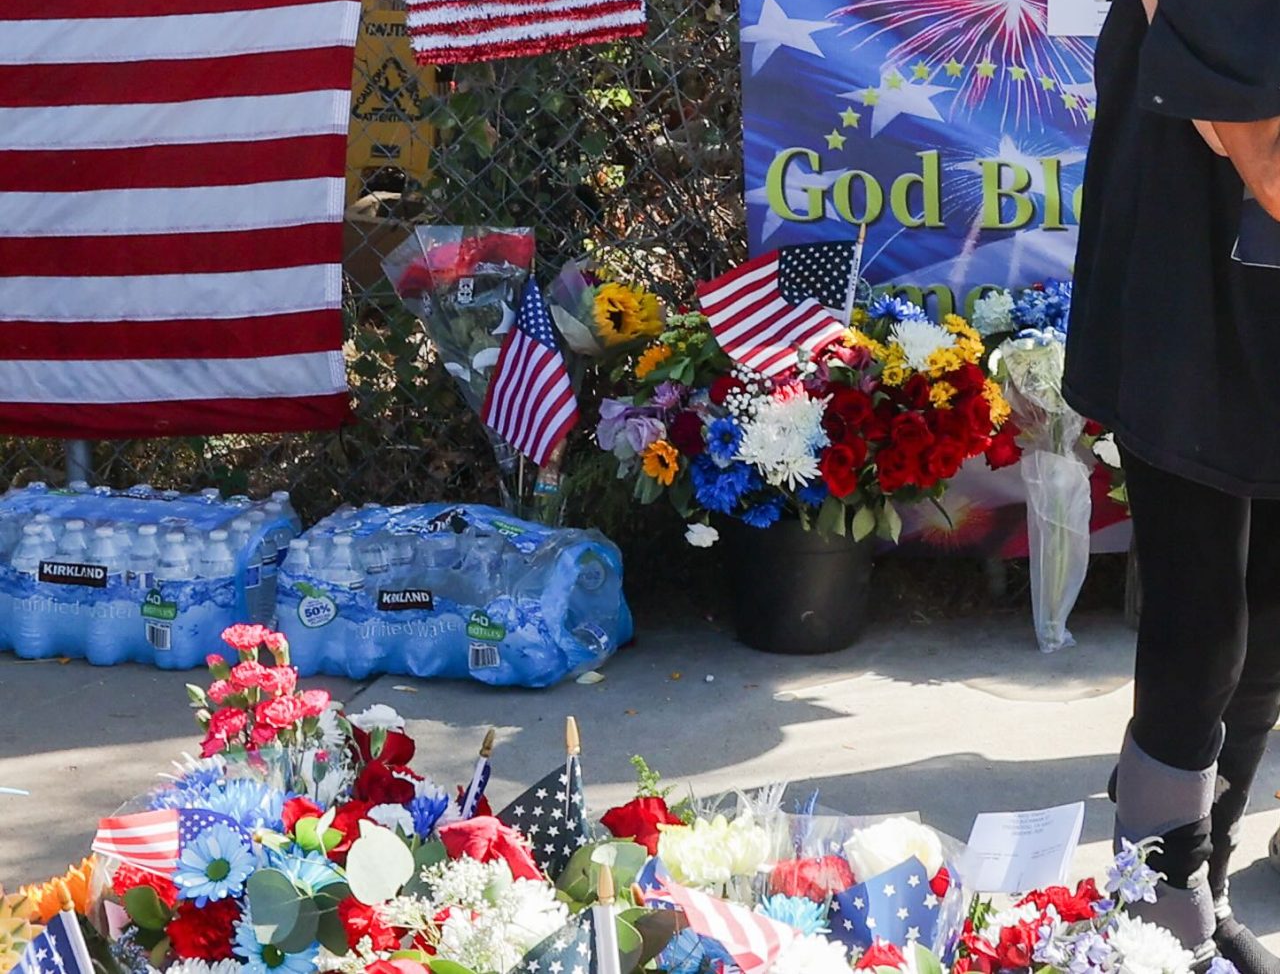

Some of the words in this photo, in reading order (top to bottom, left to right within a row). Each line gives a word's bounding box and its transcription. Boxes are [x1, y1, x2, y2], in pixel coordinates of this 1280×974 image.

[764, 146, 945, 228] God
[979, 157, 1084, 232] Bl
[43, 563, 105, 580] KIRKLAND
[304, 603, 331, 618] 50%
[471, 613, 489, 627] 40
